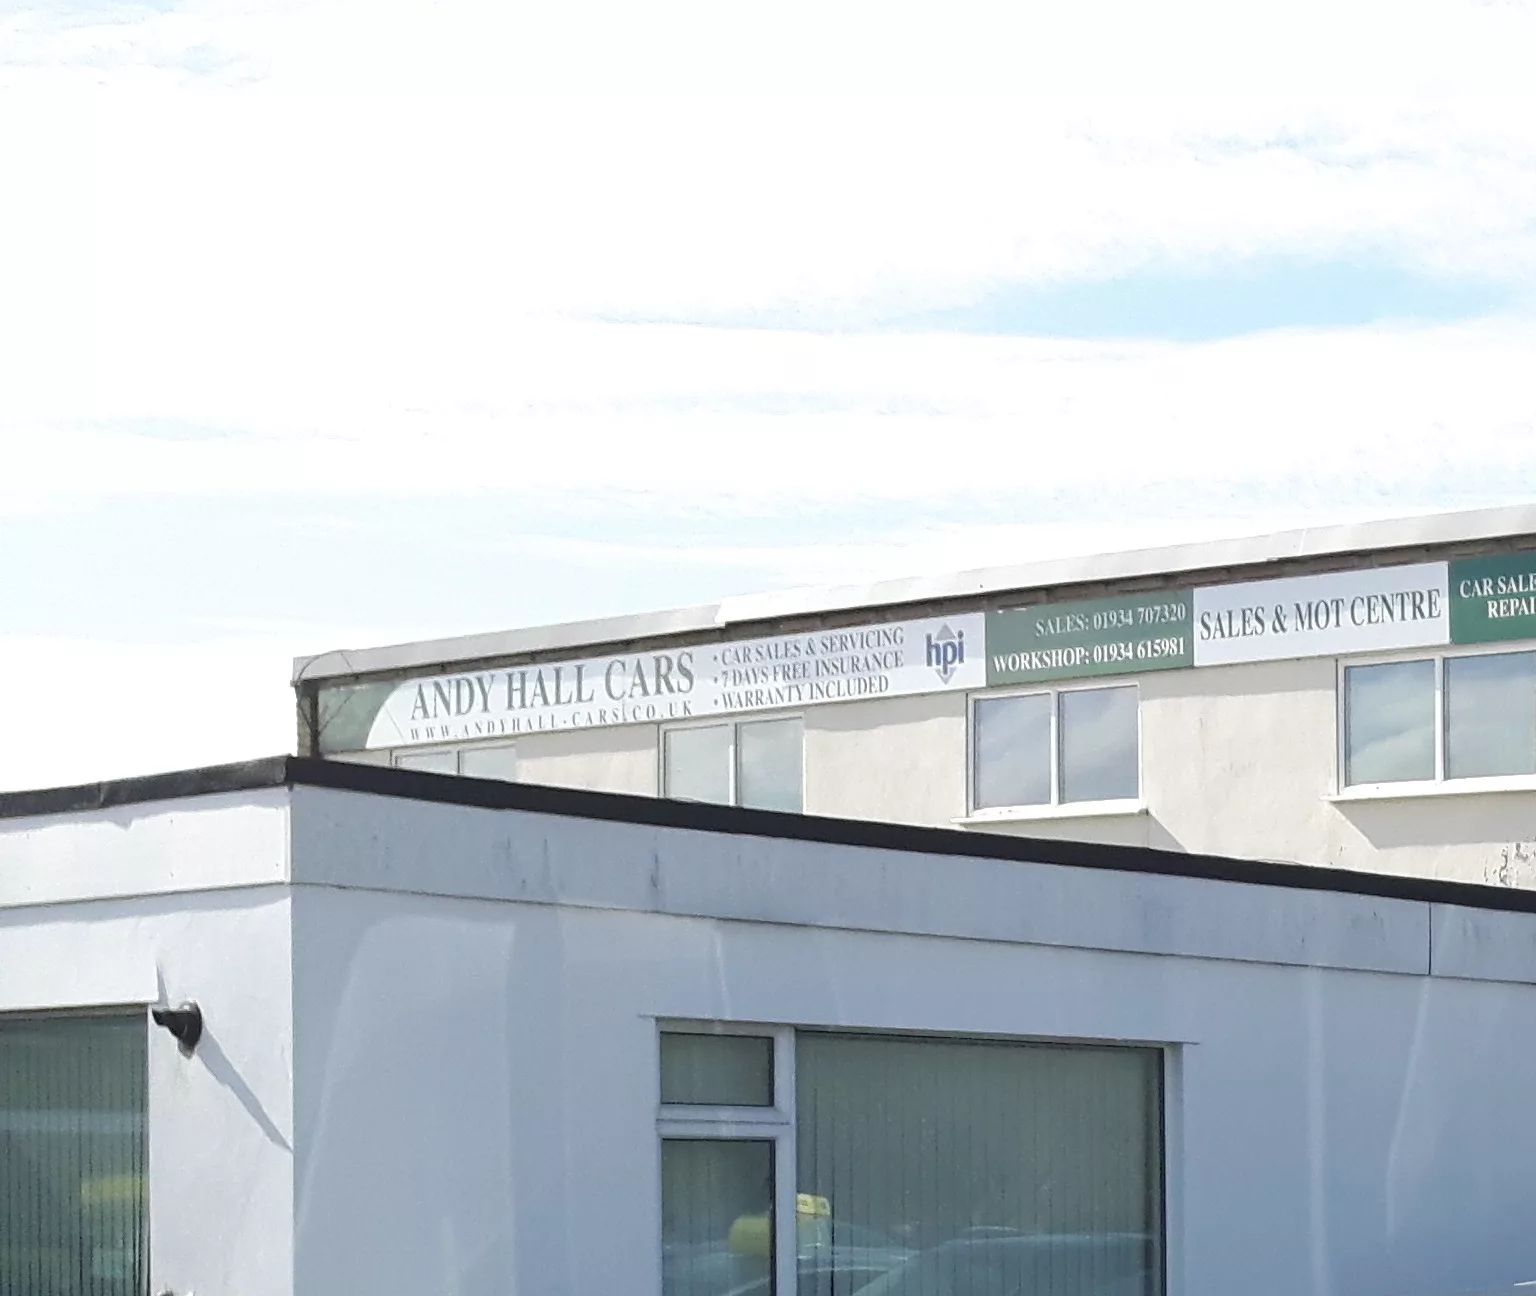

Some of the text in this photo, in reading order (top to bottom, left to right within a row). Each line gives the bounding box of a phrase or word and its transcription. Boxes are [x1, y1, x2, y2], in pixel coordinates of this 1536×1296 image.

[1460, 577, 1494, 598] CAR
[1035, 602, 1186, 637] SALES: 01934 707320
[1200, 589, 1441, 641] SALES & MOT CENTRE
[721, 627, 904, 666] CAR SALES & SERVICING
[925, 630, 965, 675] hpi
[993, 637, 1185, 673] WORKSHOP: 01934 615981
[411, 651, 695, 720] ANDY HALL CARS
[721, 650, 904, 688] 7 DAYS FREE INSURANCE
[722, 675, 889, 709] WARRANTY INCLUDED
